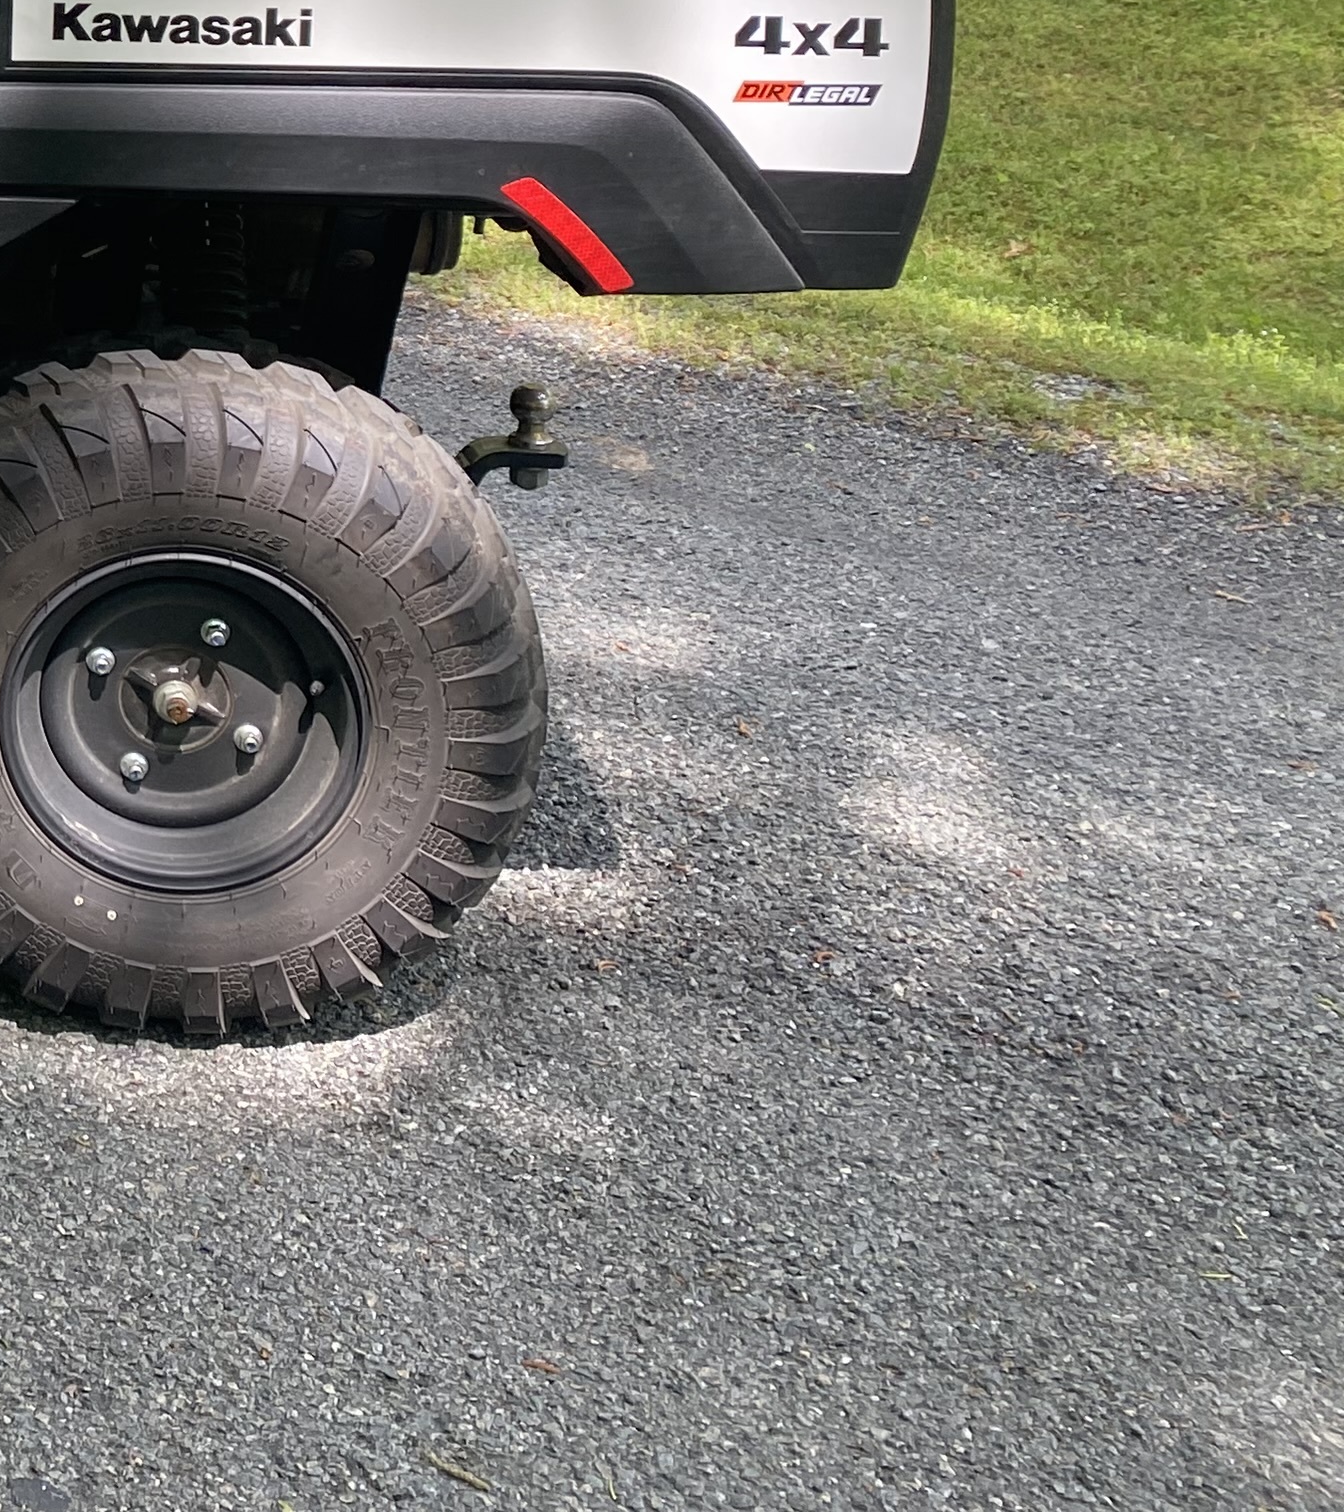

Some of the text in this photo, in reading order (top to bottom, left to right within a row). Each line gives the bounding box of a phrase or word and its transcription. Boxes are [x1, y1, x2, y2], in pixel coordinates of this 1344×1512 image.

[52, 2, 314, 48] Kawasaki
[734, 15, 890, 57] 4x4
[789, 86, 871, 104] LEGAL
[362, 616, 430, 852] FRONTIER
